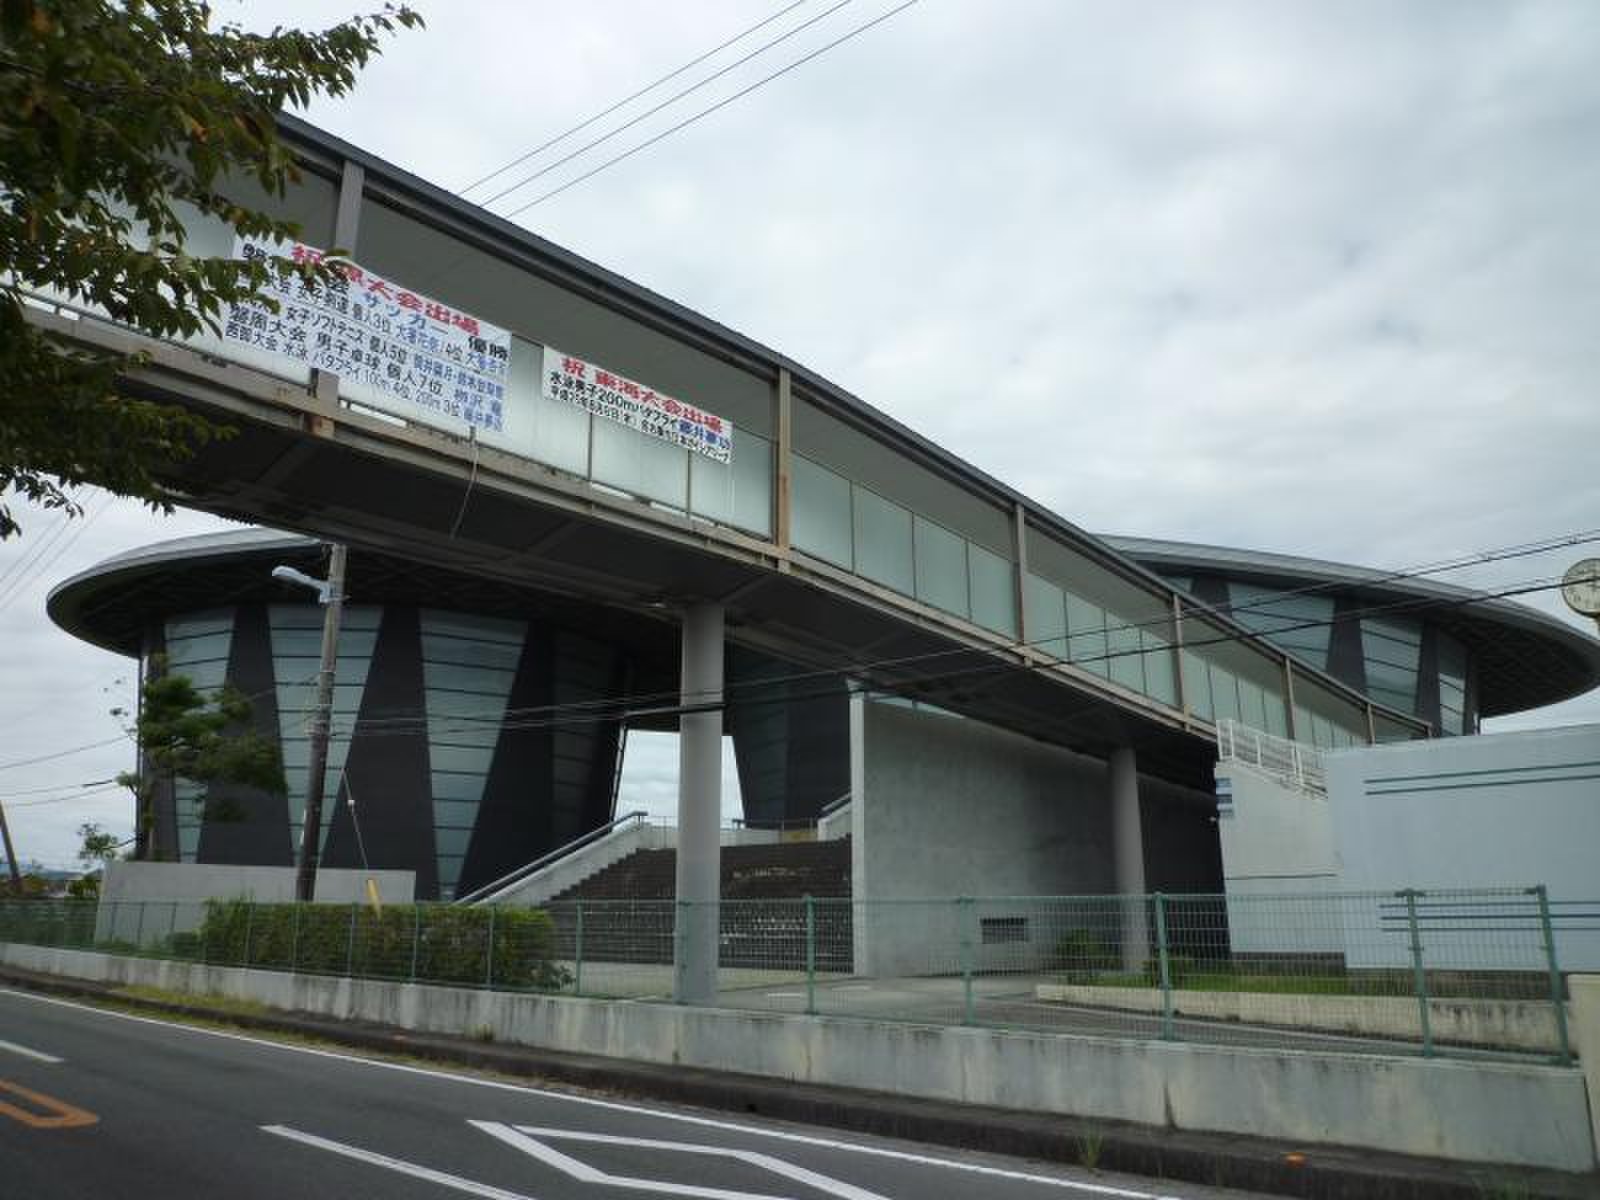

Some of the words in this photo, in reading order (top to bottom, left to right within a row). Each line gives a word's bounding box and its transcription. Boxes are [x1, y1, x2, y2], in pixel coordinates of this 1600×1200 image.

[287, 305, 365, 343] 女子ソフトテニス
[364, 292, 448, 335] サッカー
[562, 356, 586, 379] 祝
